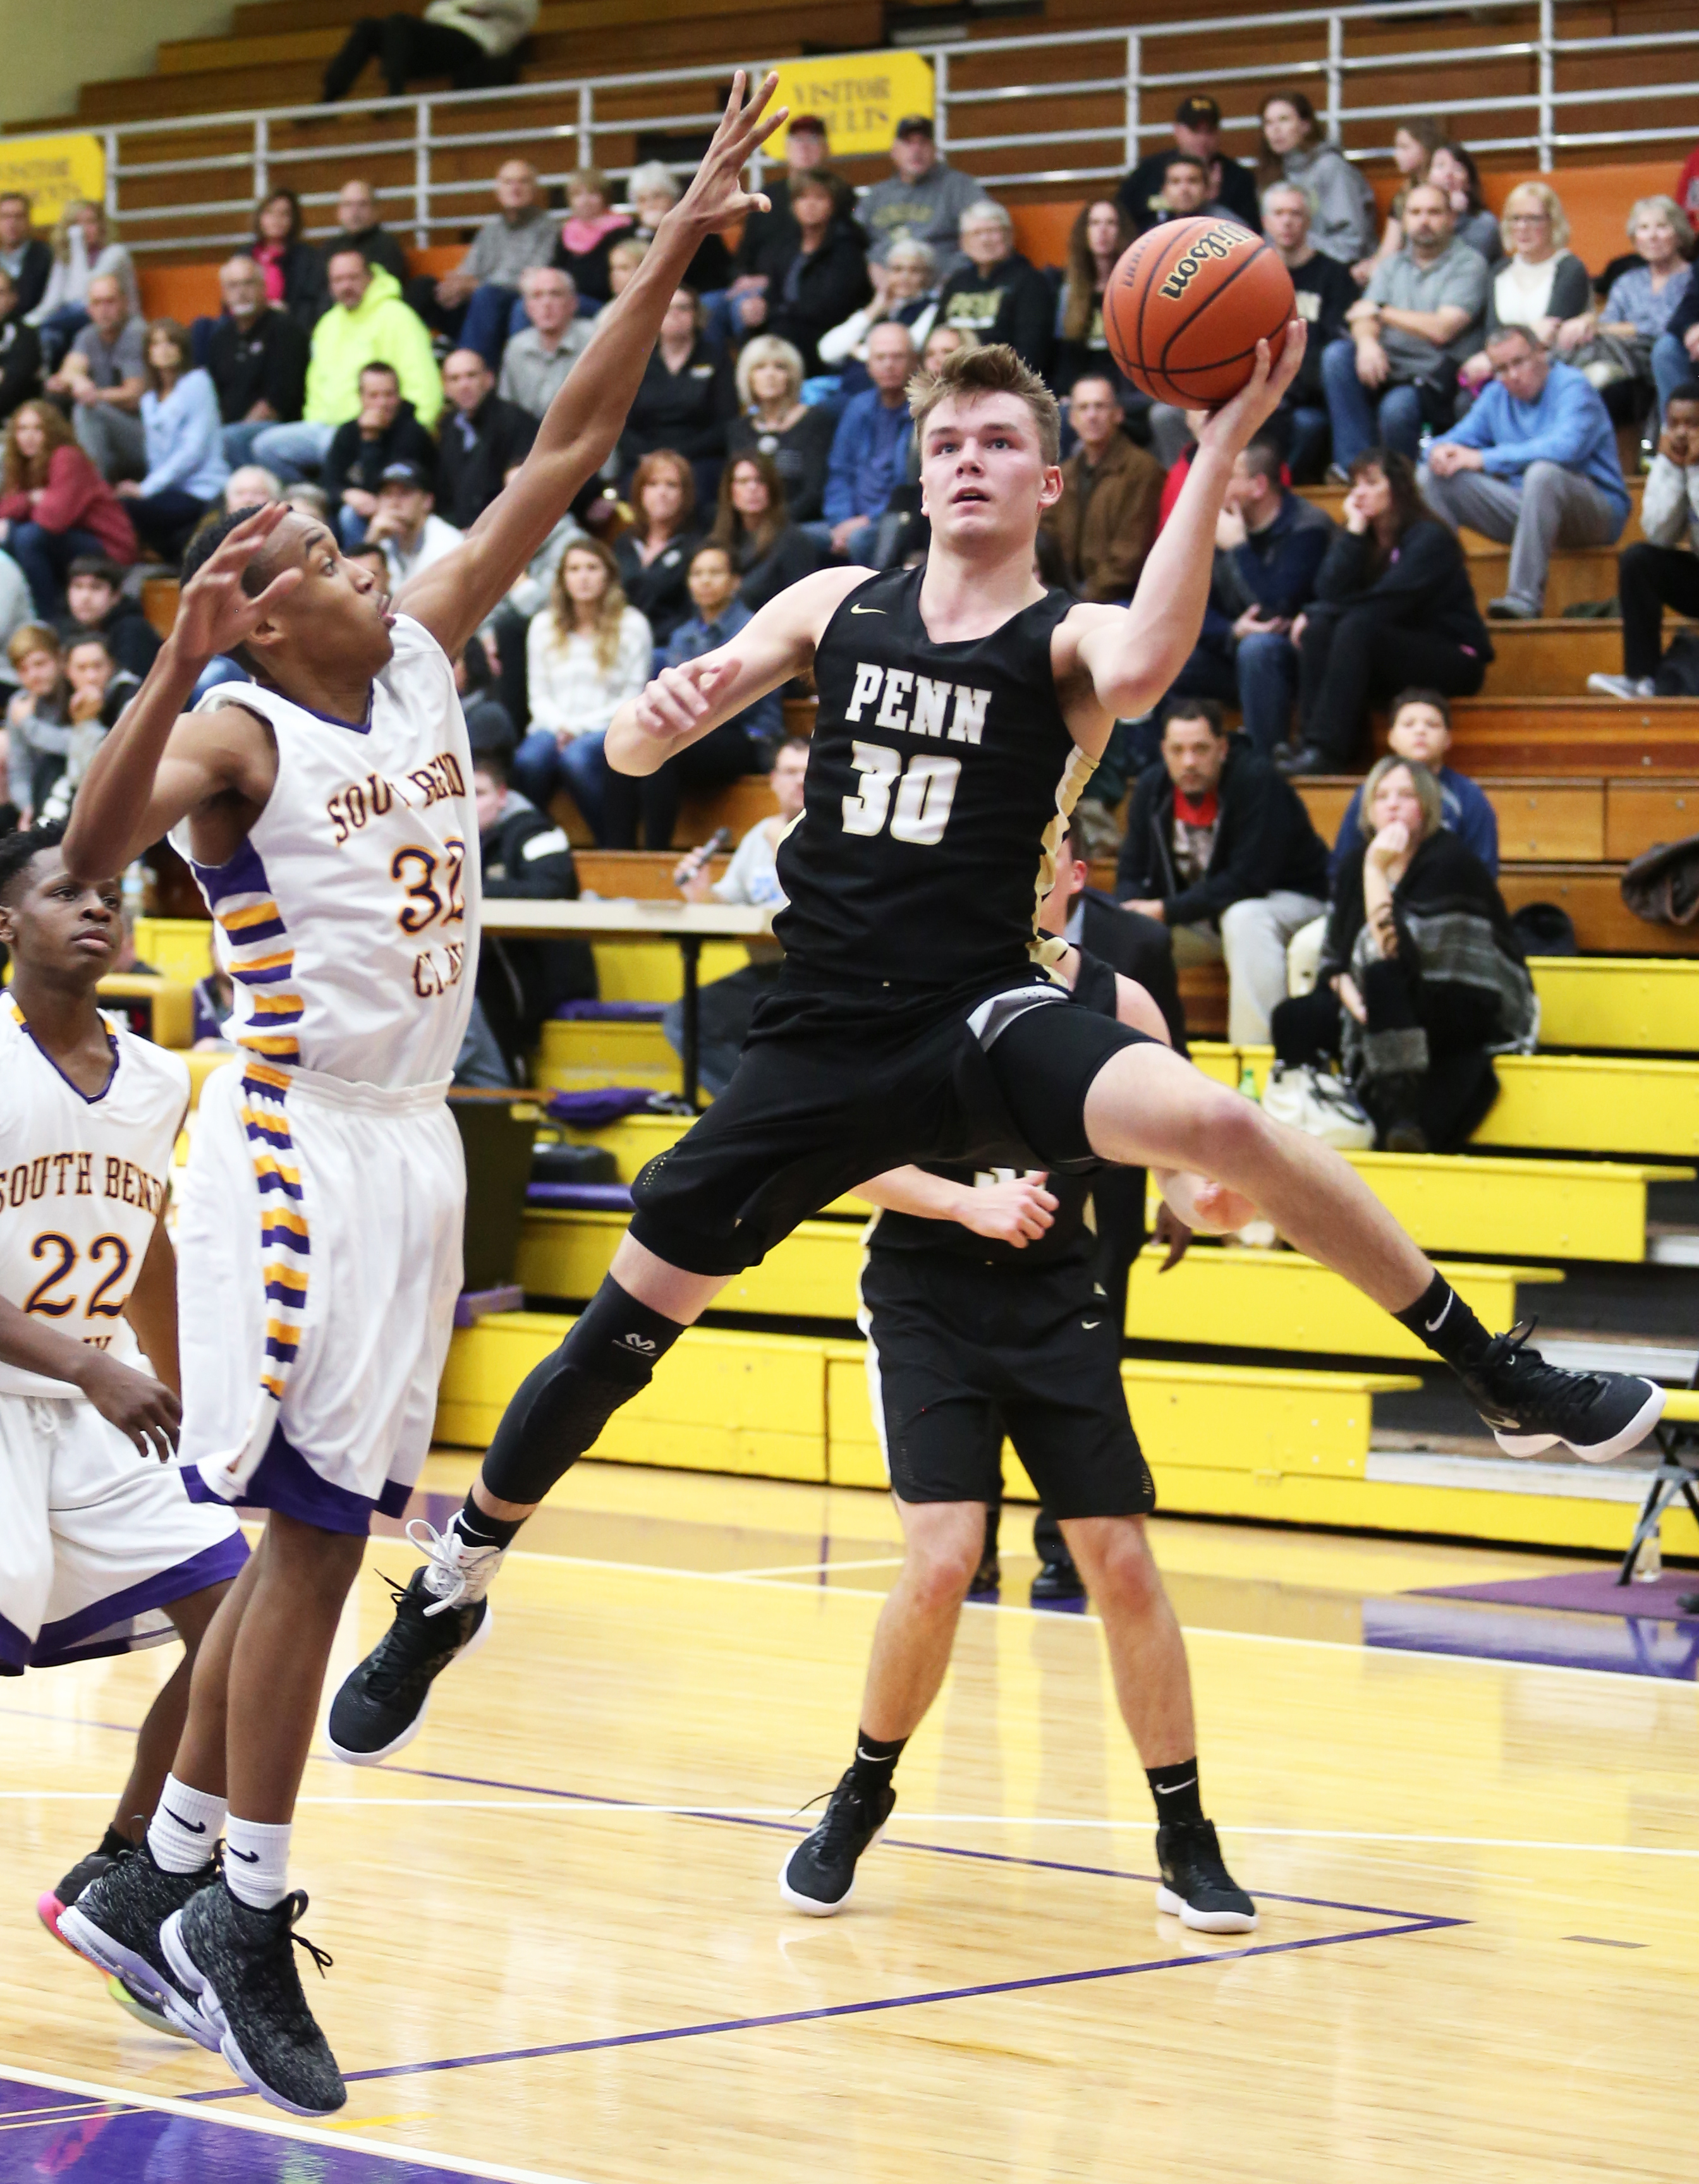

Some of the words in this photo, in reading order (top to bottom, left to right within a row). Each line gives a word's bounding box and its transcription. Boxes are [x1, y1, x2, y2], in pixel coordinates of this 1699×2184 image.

[793, 74, 891, 106] VISITOR
[1157, 221, 1258, 301] Wilson
[844, 662, 992, 745] PENN
[327, 772, 412, 848] SOU
[842, 740, 962, 846] 30
[389, 835, 466, 937] 32
[23, 1229, 133, 1320] 22
